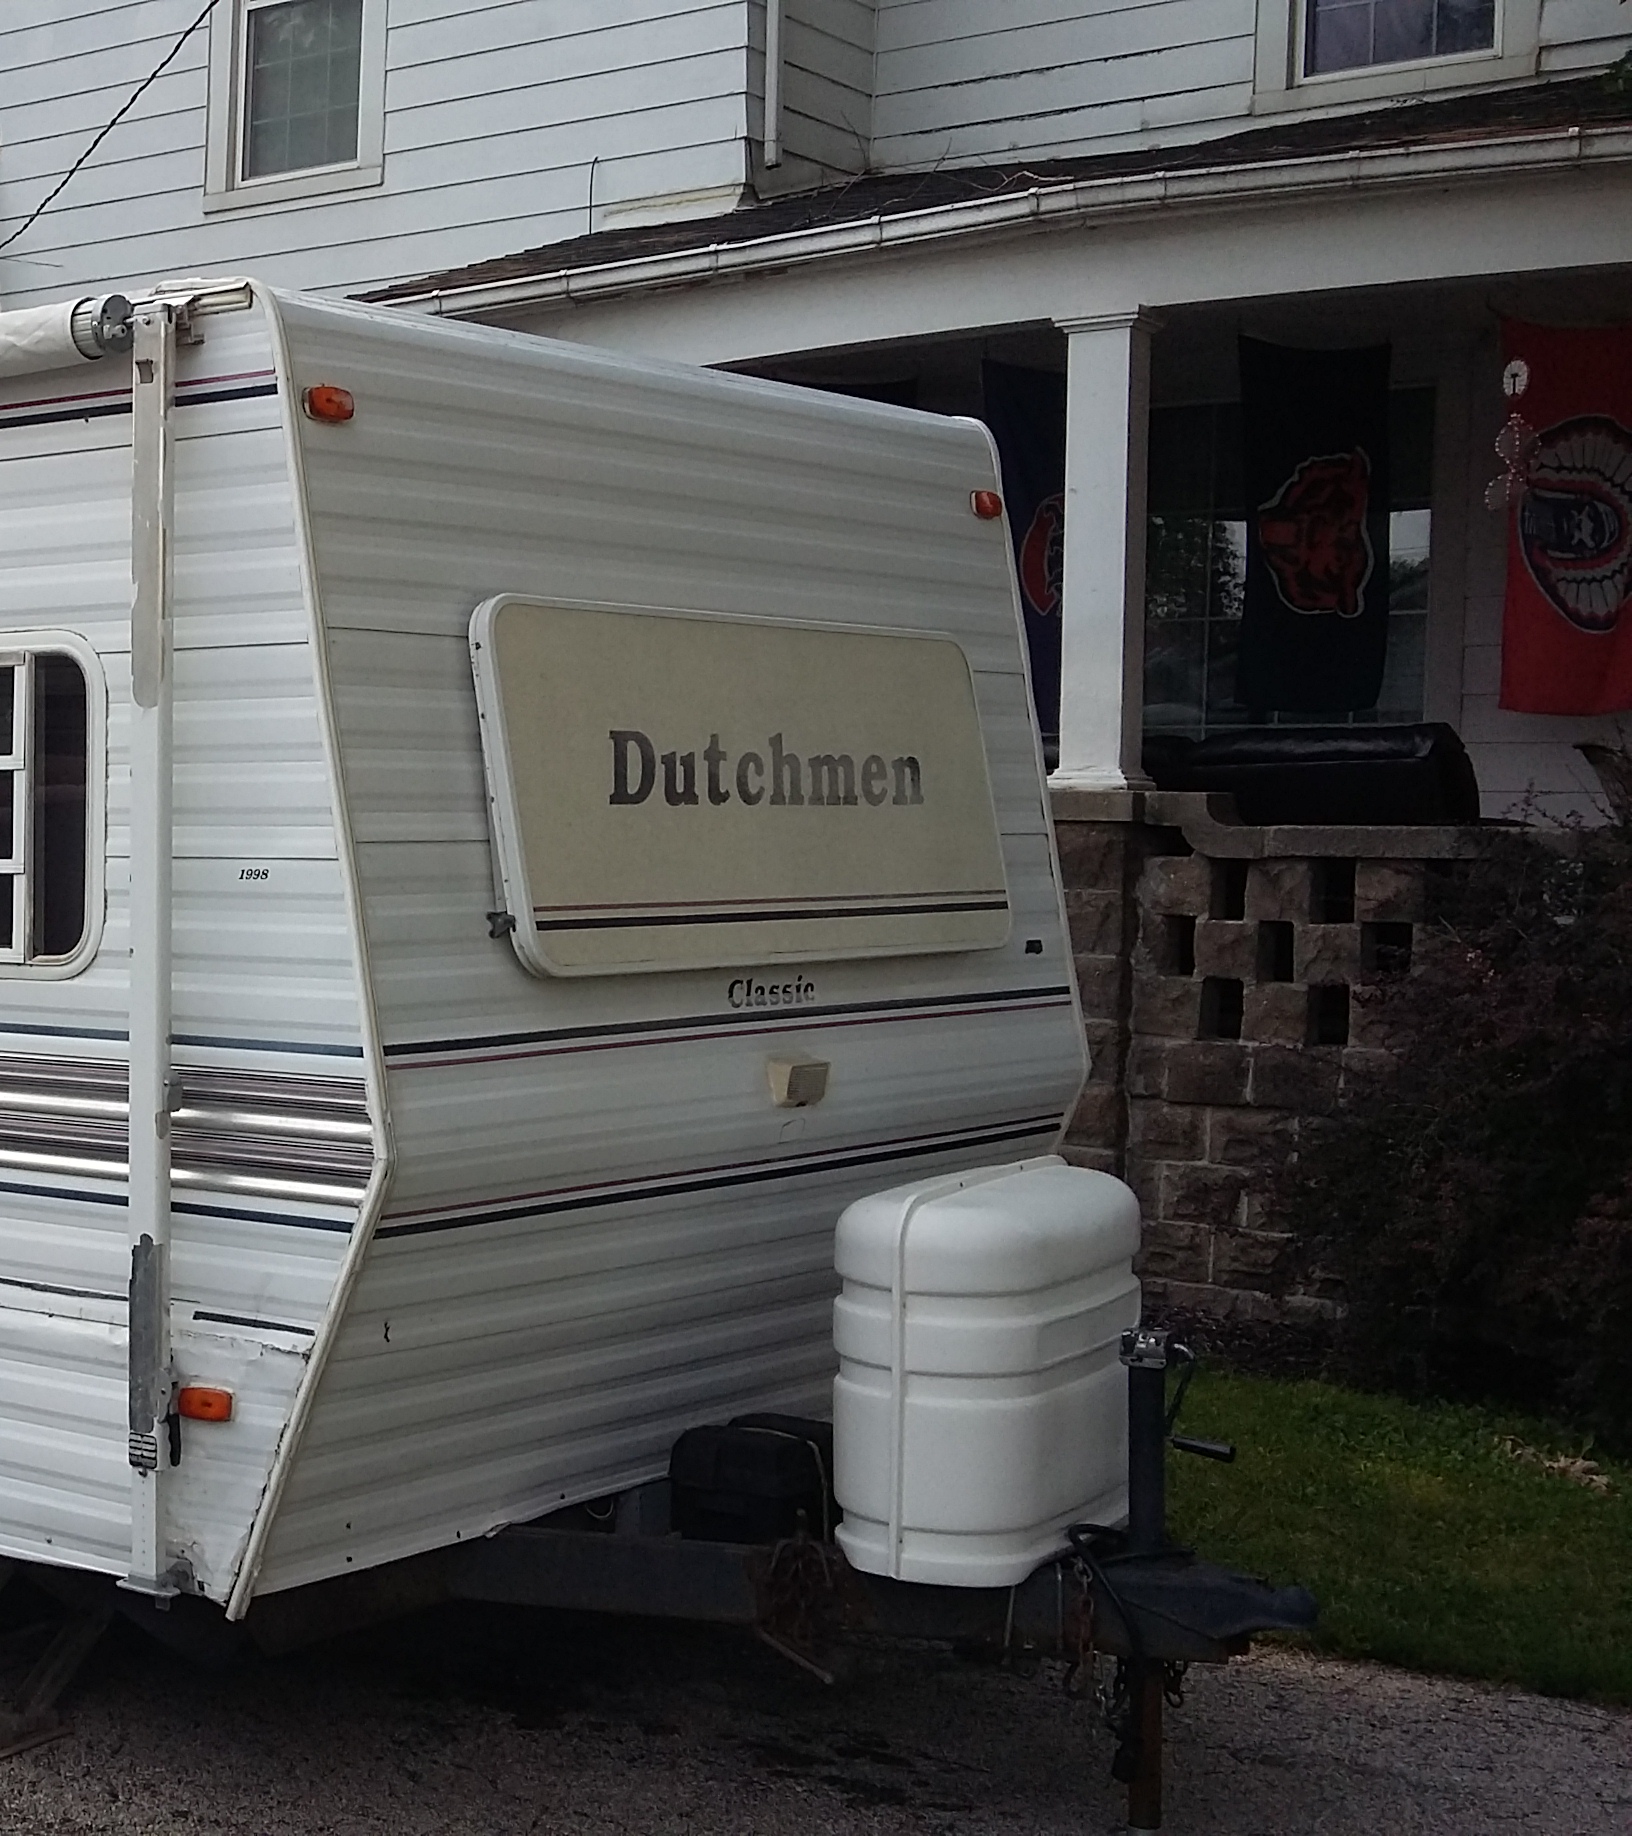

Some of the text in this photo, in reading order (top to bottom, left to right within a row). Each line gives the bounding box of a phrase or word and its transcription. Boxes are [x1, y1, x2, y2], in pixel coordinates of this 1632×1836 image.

[608, 729, 924, 806] Dutchmen
[238, 868, 270, 880] 1998
[728, 975, 815, 1009] Classic
